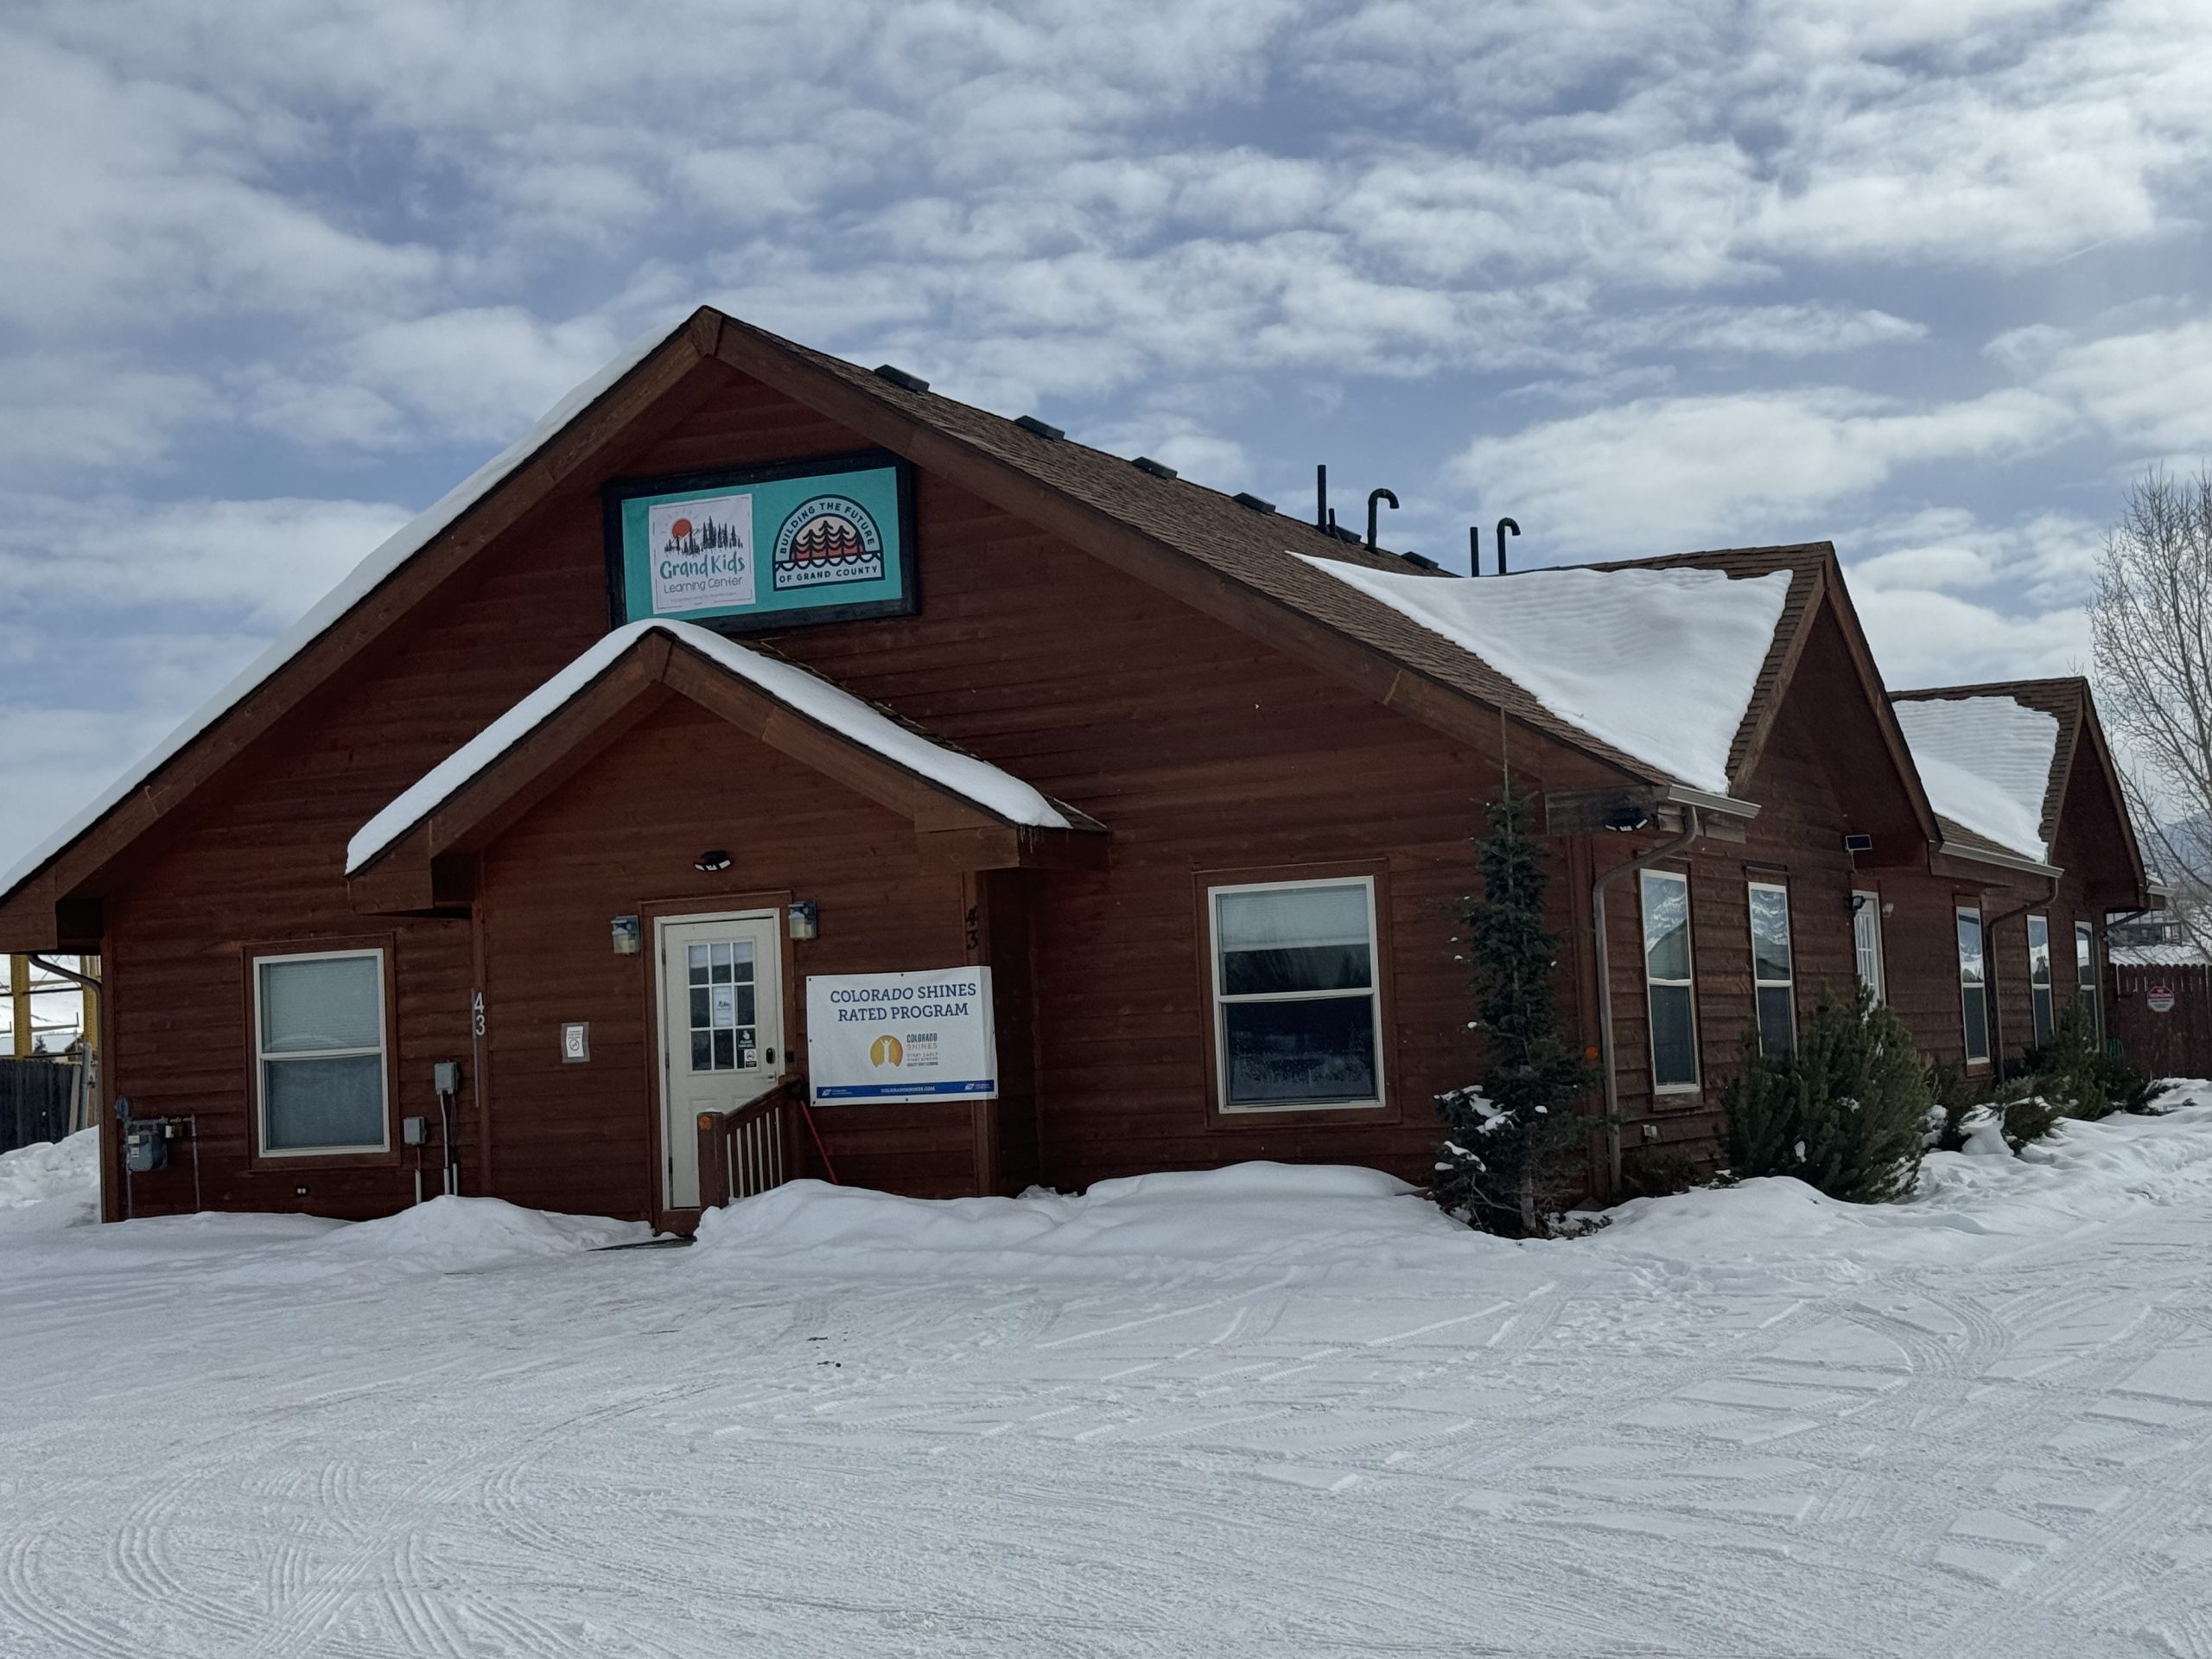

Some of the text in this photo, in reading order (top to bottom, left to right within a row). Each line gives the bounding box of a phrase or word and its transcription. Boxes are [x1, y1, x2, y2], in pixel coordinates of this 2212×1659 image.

[780, 502, 875, 555] BUILDING THE FUTURE
[779, 565, 878, 583] OF GRAND COUNTY
[664, 575, 743, 594] Learning Center
[830, 982, 976, 1004] COLORADO SHINES
[474, 991, 486, 1037] 43
[838, 1002, 969, 1022] RATED PROGRAM
[906, 1033, 938, 1043] COLORADO
